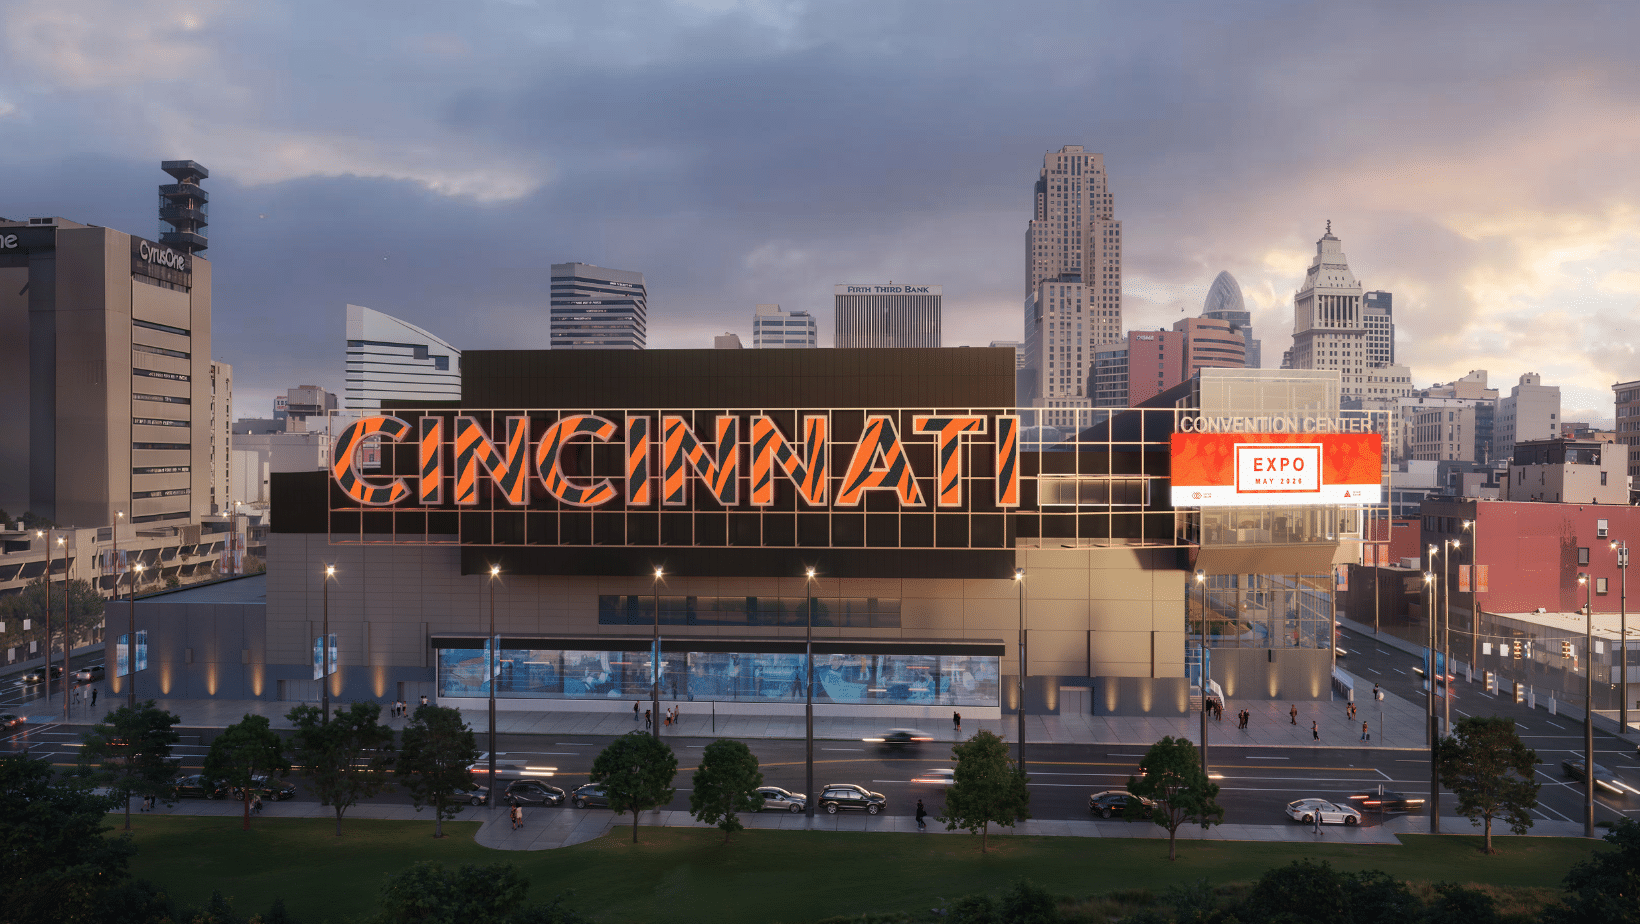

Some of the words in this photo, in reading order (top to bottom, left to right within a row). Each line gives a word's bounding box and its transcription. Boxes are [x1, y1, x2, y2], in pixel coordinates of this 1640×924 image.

[140, 240, 185, 271] CyrusOne
[1180, 416, 1298, 433] CONVENTION
[1303, 416, 1373, 433] CENTER
[331, 414, 1020, 507] CINCINNATI
[1253, 457, 1305, 472] EXPO
[1255, 477, 1274, 485] MAY
